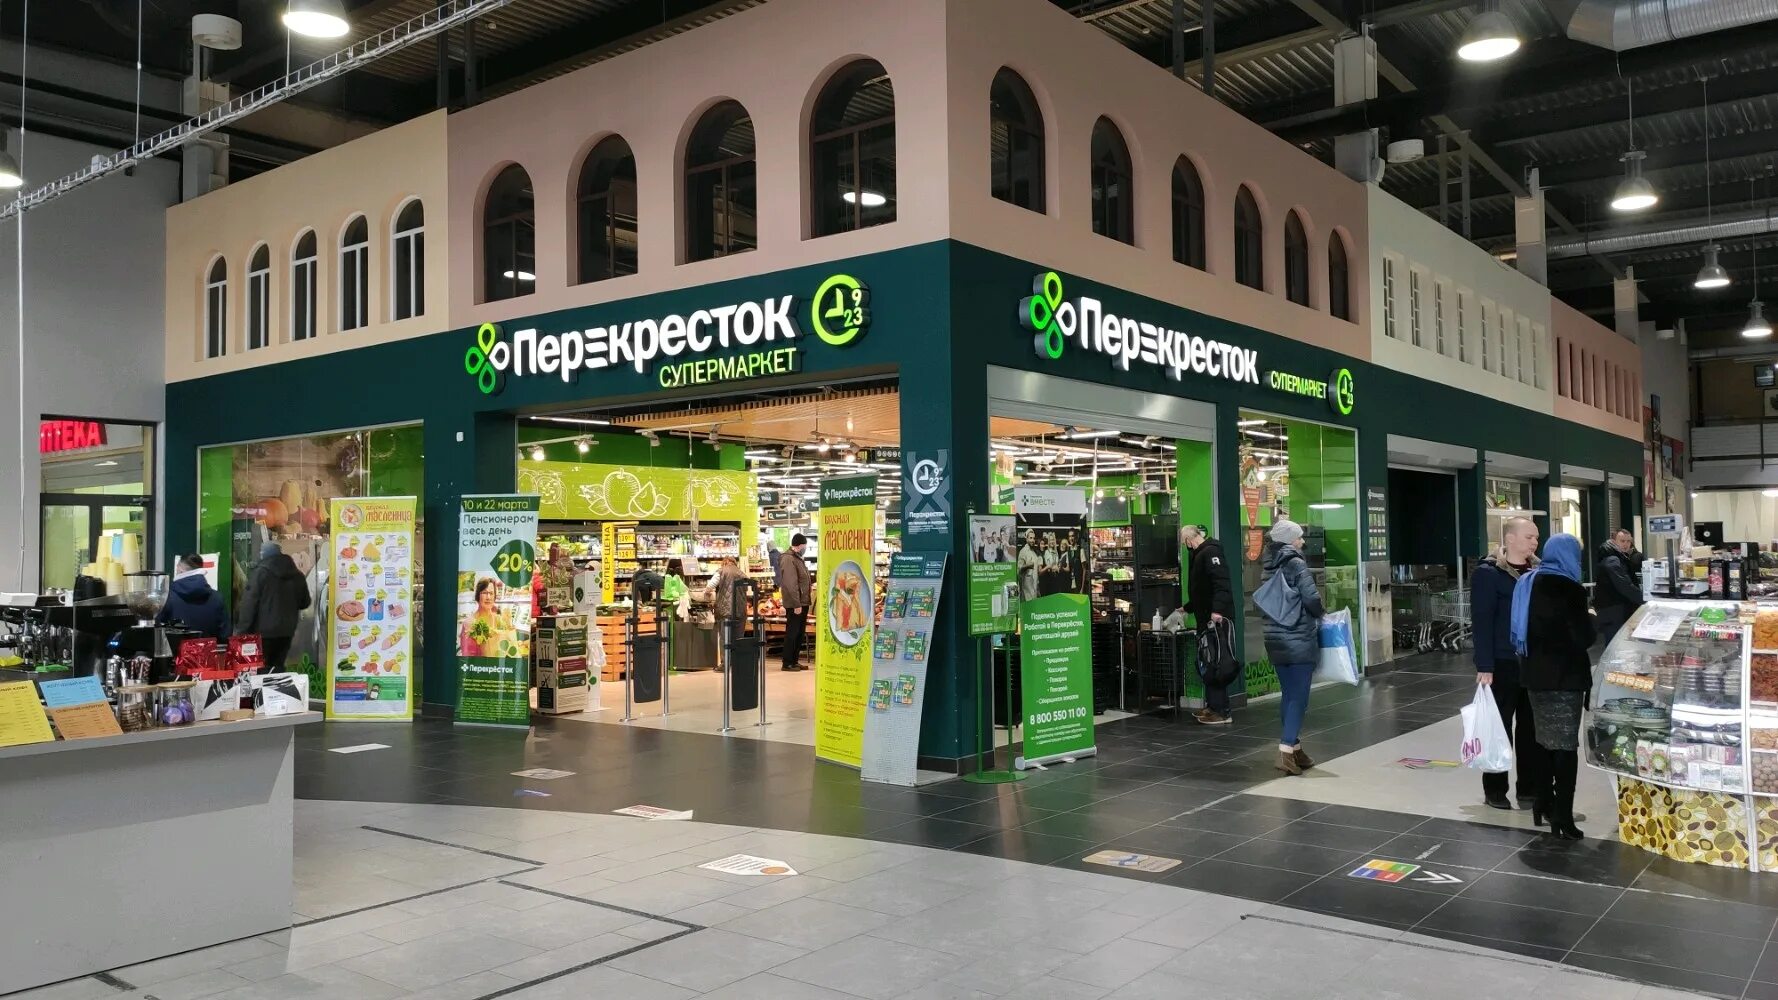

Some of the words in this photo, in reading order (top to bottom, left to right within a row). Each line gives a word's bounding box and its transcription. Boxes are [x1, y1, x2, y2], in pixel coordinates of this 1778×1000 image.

[843, 307, 863, 327] 23
[659, 347, 797, 389] СУПЕРМАРКЕТ
[1270, 370, 1327, 400] СУПЕРМАРКЕТ
[463, 500, 474, 510] 10
[476, 502, 483, 510] и
[484, 500, 495, 510] 22
[498, 501, 529, 511] марта
[463, 514, 534, 525] Пенсионерам
[462, 527, 486, 535] весь
[488, 527, 512, 537] день
[498, 553, 533, 573] 20%
[1031, 612, 1056, 621] Поделись
[1029, 714, 1036, 725] 8
[1036, 712, 1052, 724] 800
[1052, 709, 1067, 722] 550
[1068, 708, 1075, 719] 11
[1075, 706, 1087, 717] 00
